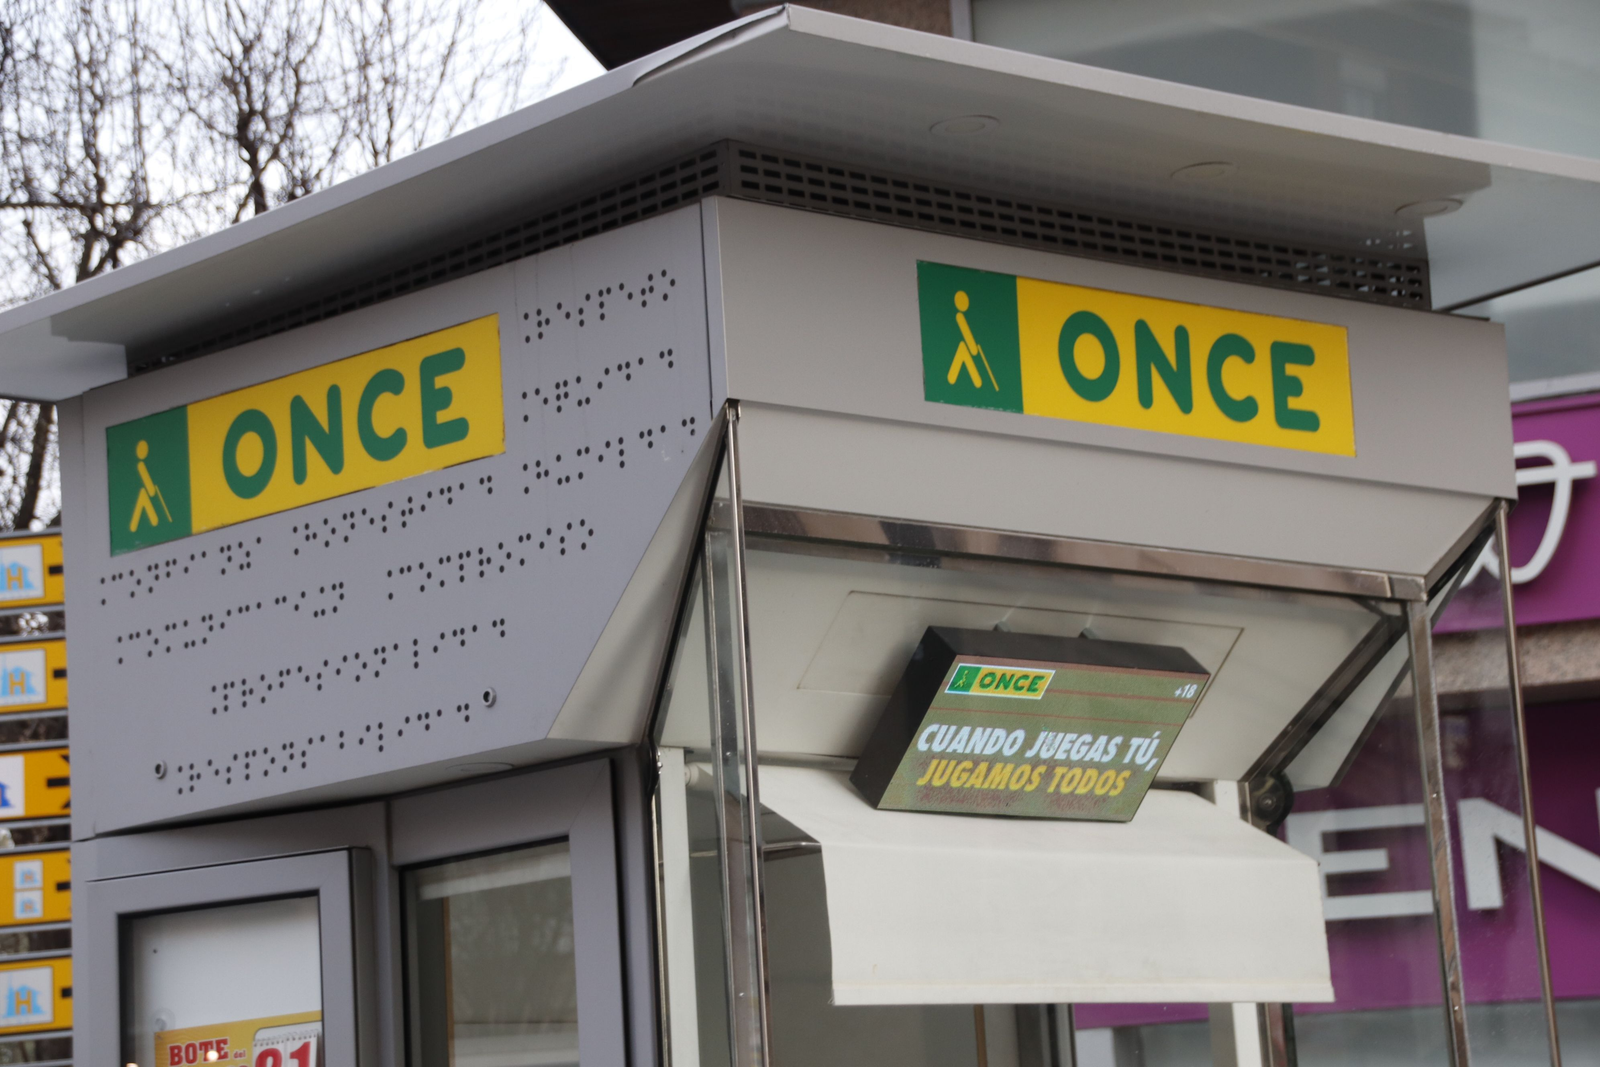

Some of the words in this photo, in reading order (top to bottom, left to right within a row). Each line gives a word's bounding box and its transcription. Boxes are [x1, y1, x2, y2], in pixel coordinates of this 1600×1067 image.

[1057, 310, 1321, 433] ONCE
[222, 346, 470, 500] ONCE
[979, 672, 1046, 693] ONCE
[1174, 684, 1198, 699] +18
[917, 724, 1026, 757] CUANDO
[1025, 731, 1124, 764] JUEGAS
[1122, 731, 1162, 771] TÚ,
[916, 759, 1047, 792] JUGAMOS
[1047, 766, 1131, 797] TODOS
[169, 1038, 229, 1066] BOTE
[233, 1050, 246, 1059] del
